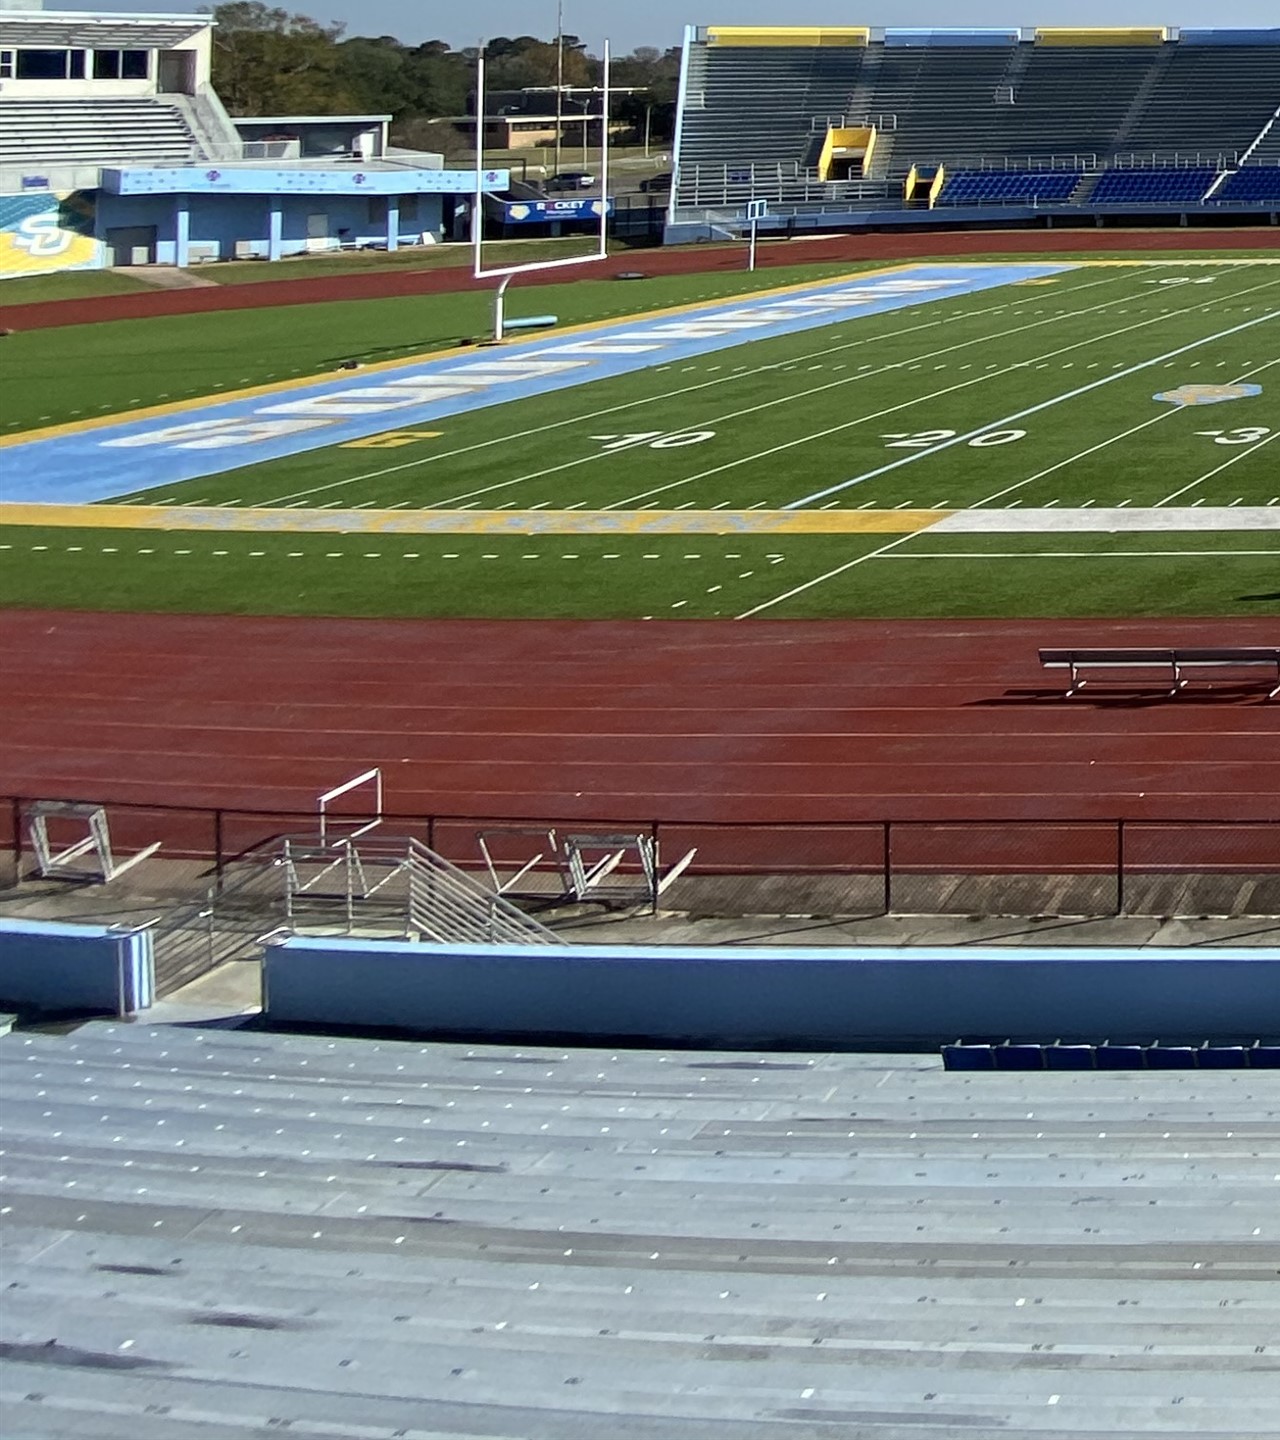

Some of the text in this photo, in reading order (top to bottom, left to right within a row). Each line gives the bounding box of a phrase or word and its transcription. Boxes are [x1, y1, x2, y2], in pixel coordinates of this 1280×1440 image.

[536, 201, 584, 210] ROCKET
[96, 279, 973, 450] SOUTHERN
[601, 431, 717, 449] 10
[884, 429, 1027, 448] 20
